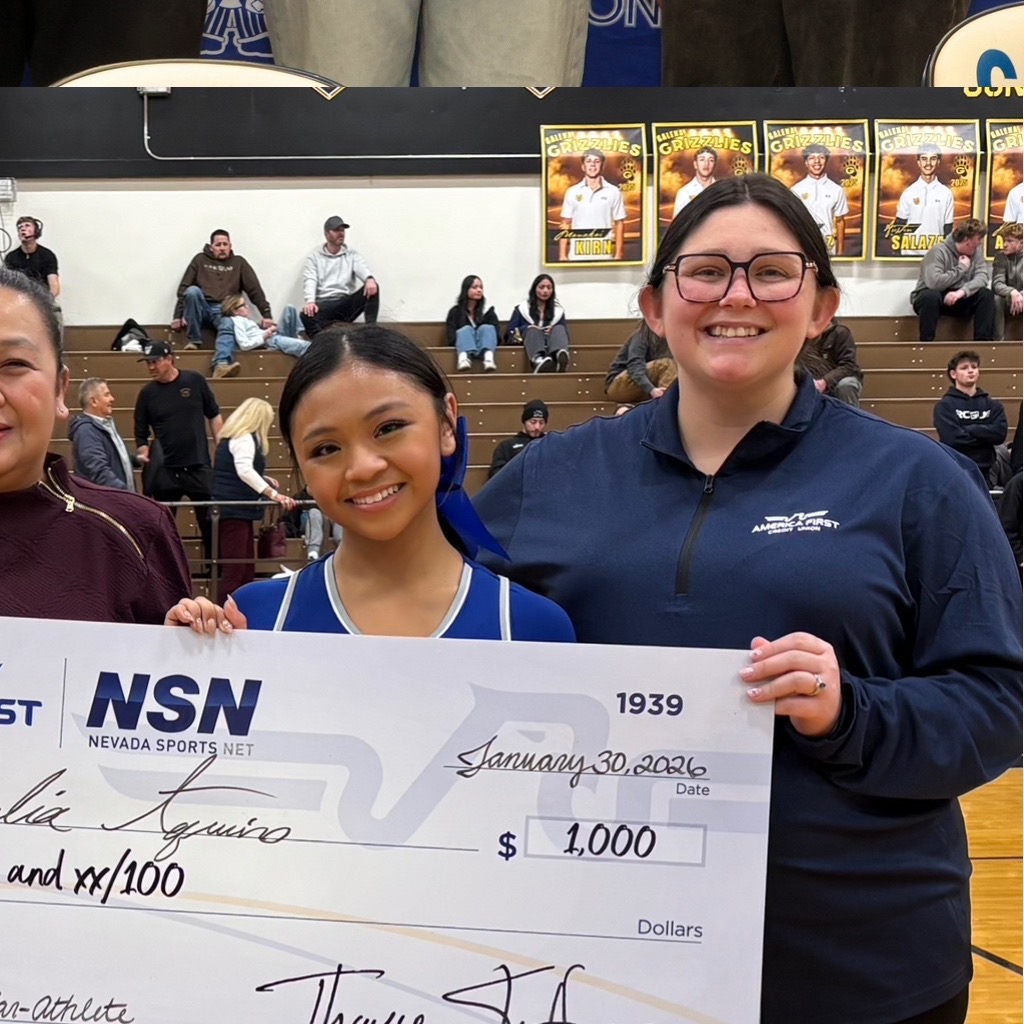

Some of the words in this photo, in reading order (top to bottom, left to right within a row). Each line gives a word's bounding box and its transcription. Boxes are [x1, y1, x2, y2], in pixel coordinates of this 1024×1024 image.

[547, 138, 641, 157] GRIZZLIES
[659, 136, 752, 155] GRIZZLIES
[770, 134, 864, 153] GRIZZLIES
[881, 133, 975, 152] GRIZZLIES
[574, 239, 614, 256] KIRN
[751, 521, 803, 533] AMERICA
[805, 518, 840, 529] FIRST
[86, 671, 263, 736] NSN
[616, 692, 684, 716] 1939
[88, 735, 151, 751] NEVADA
[156, 739, 218, 754] SPORTS
[223, 742, 254, 756] NET
[456, 734, 589, 788] January
[676, 782, 710, 796] Date
[497, 830, 517, 861] $
[563, 822, 657, 858] 1,000
[6, 848, 64, 891] and
[73, 848, 185, 905] xx/100
[637, 919, 703, 938] Dollars
